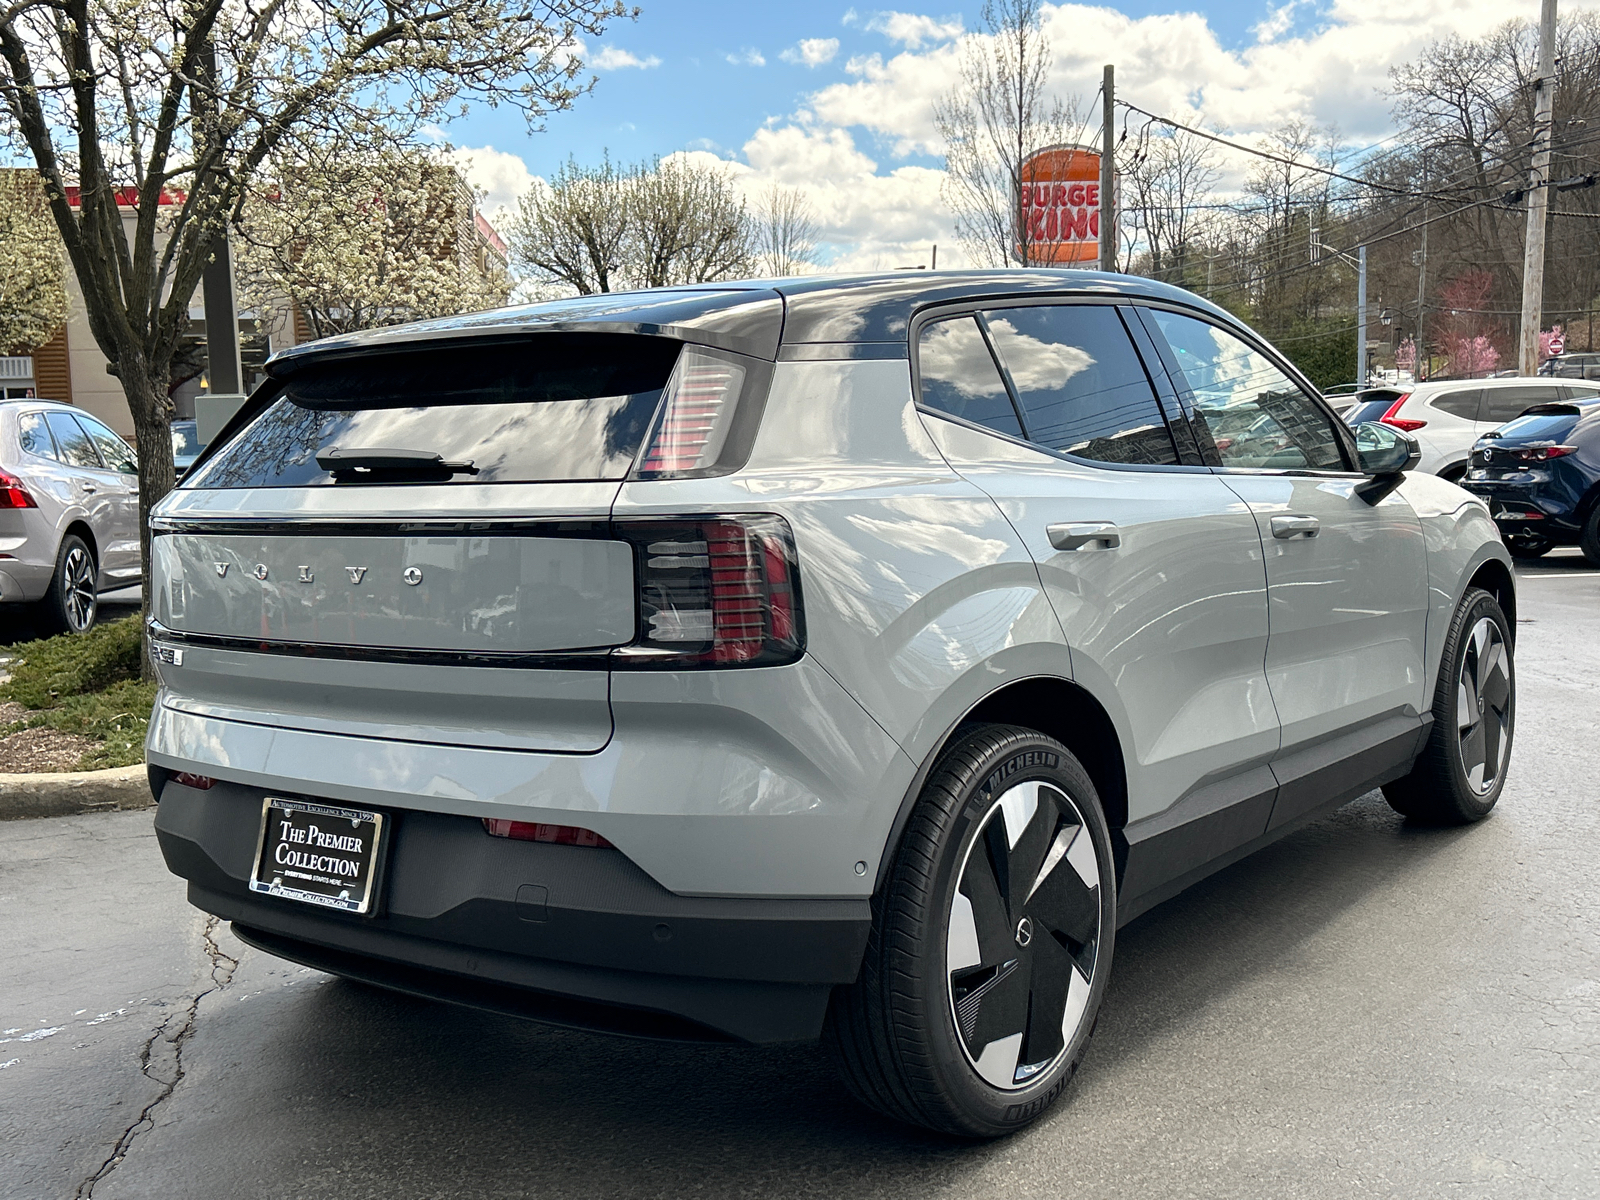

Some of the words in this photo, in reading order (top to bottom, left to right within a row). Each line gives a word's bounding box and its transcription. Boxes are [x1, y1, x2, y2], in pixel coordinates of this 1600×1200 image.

[1019, 184, 1100, 208] BURGE
[213, 562, 423, 586] VOLVO
[988, 752, 1056, 791] MICHELIN
[280, 821, 306, 844] THE
[306, 825, 363, 853] PREMIER
[275, 843, 361, 877] COLLECTION
